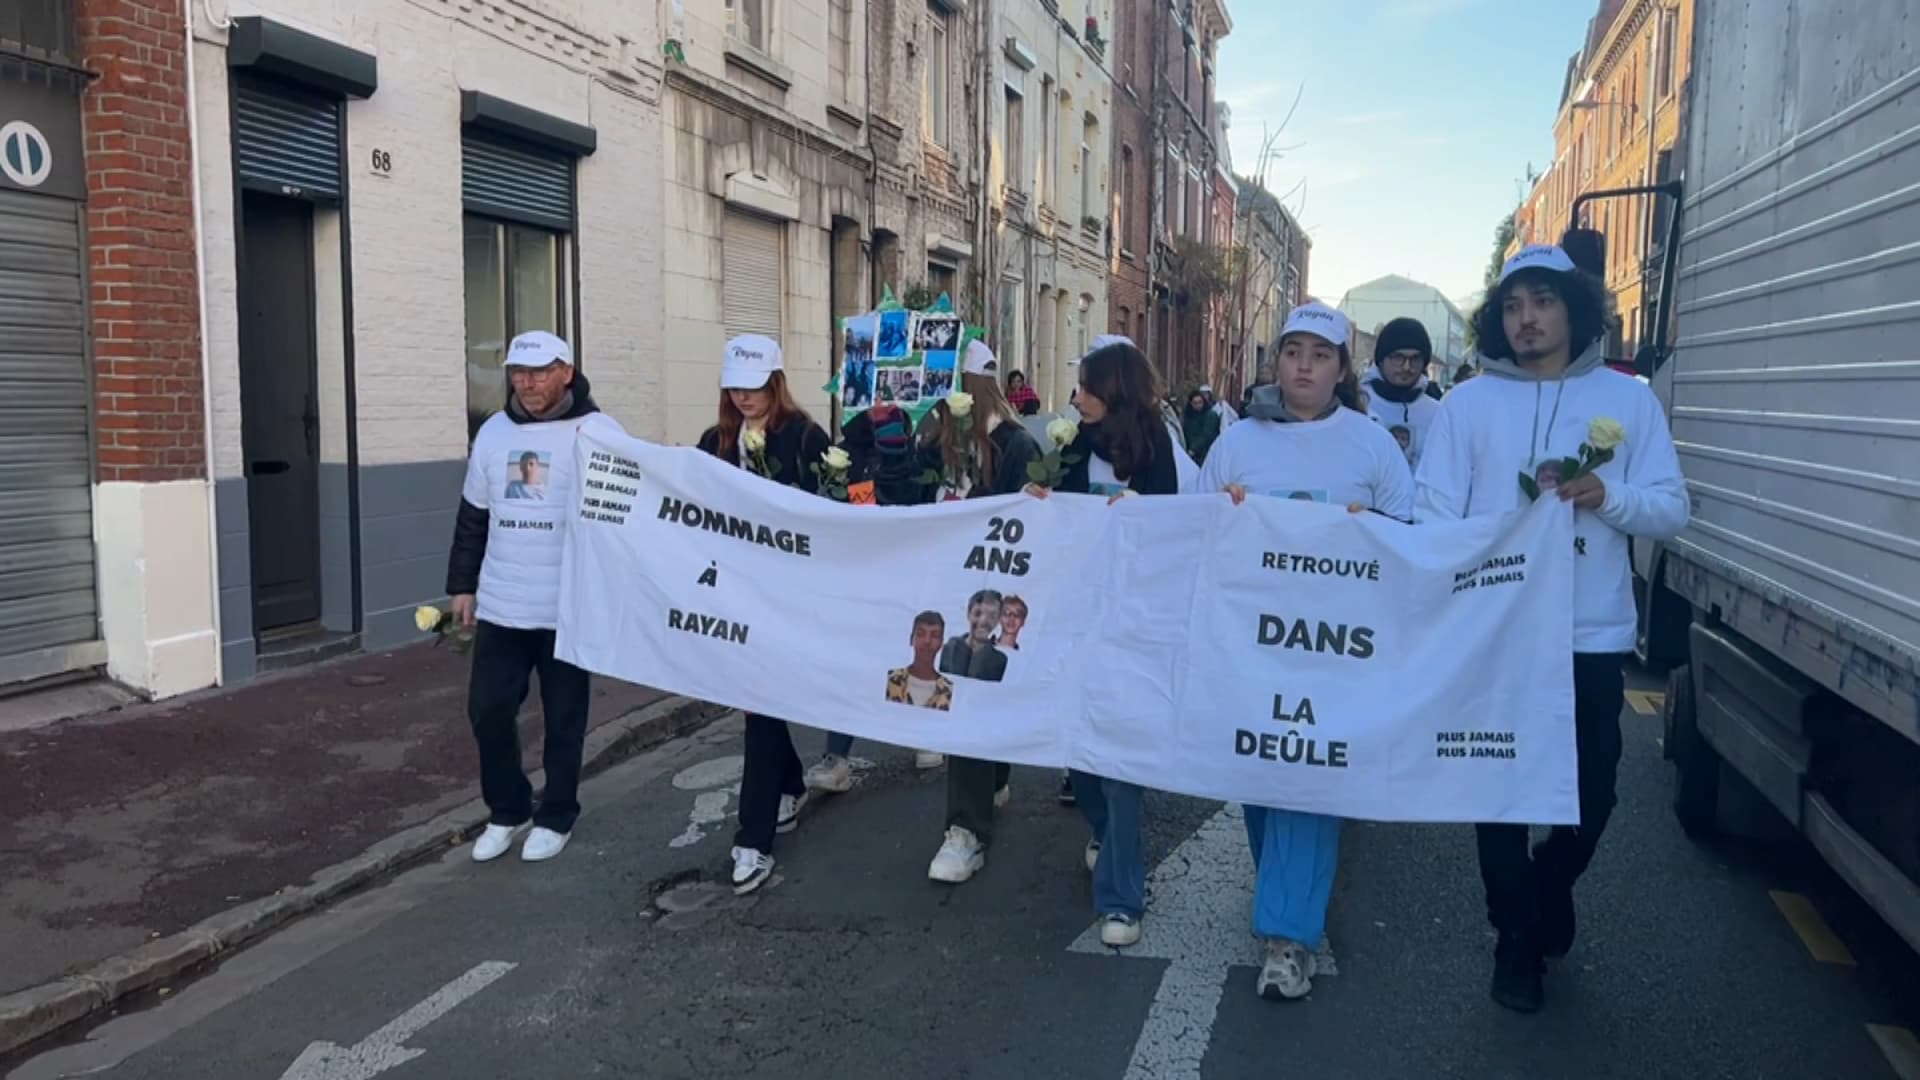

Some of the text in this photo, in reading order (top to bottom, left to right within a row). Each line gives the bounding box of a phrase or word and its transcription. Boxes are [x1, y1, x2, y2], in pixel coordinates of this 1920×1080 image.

[372, 149, 391, 172] 68
[518, 519, 554, 531] JAMAIS
[657, 496, 811, 557] HOMMAGE
[984, 516, 1025, 545] 20
[697, 560, 717, 587] À
[963, 545, 1032, 577] ANS
[1262, 551, 1381, 582] RETROUVÉ
[1480, 553, 1526, 572] JAMAIS
[1480, 571, 1525, 588] JAMAIS
[668, 608, 749, 645] RAYAN
[1257, 613, 1376, 660] DANS
[1272, 693, 1316, 726] LA
[1234, 728, 1349, 768] DEÛLE
[1437, 731, 1516, 743] PLUS JAMAIS
[1437, 747, 1517, 760] PLUS JAMAIS
